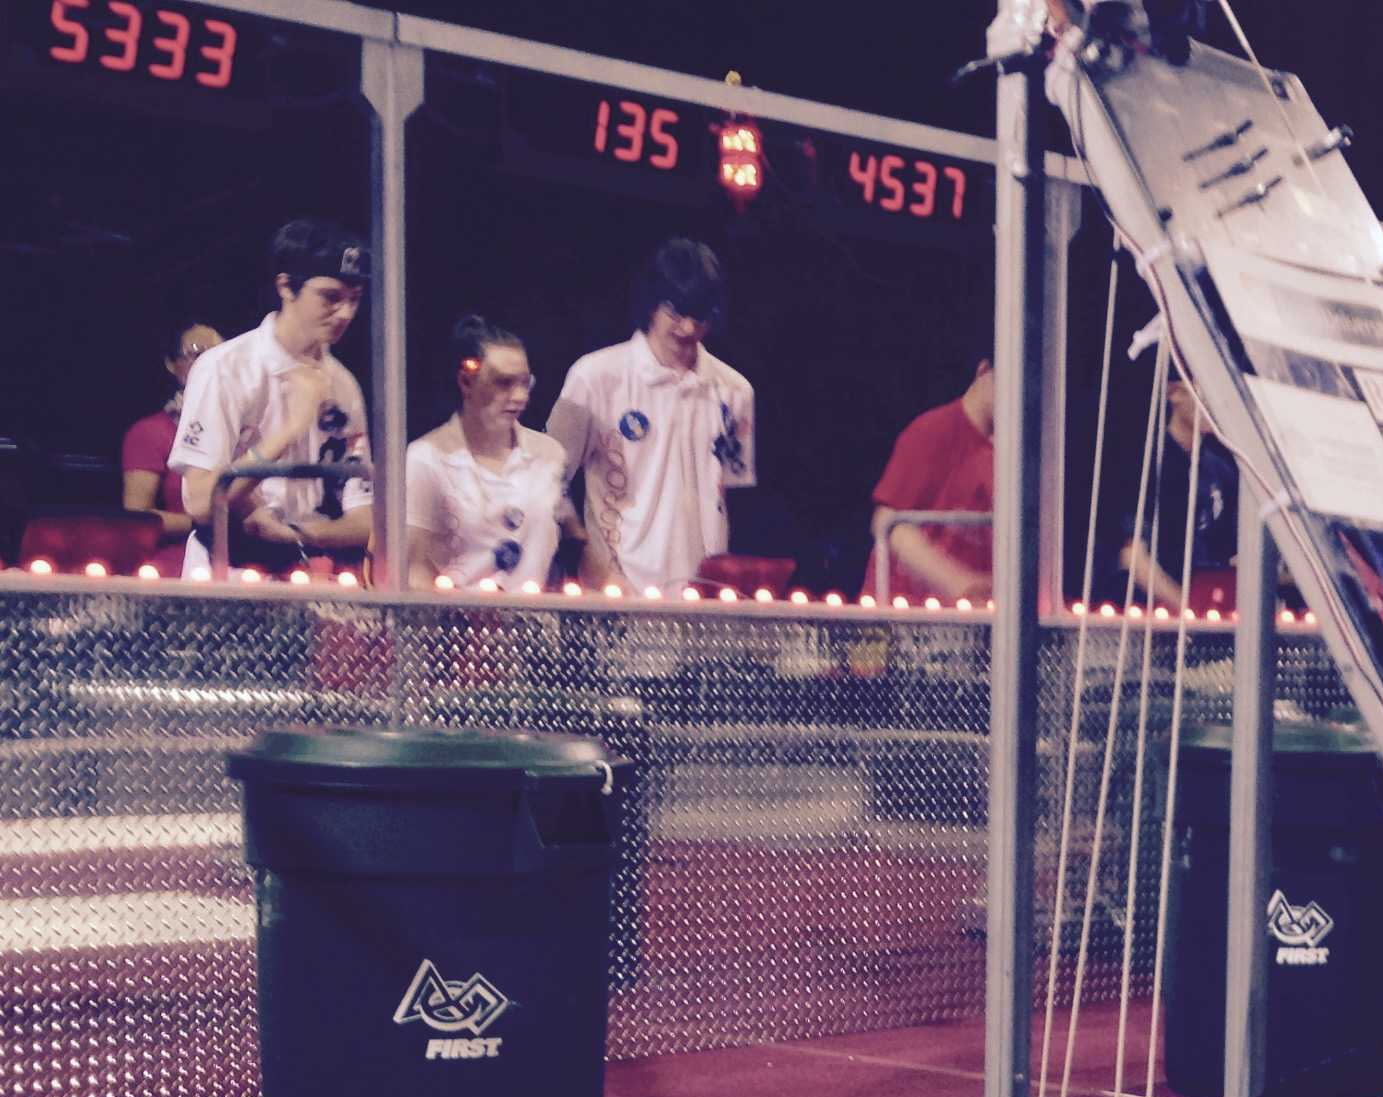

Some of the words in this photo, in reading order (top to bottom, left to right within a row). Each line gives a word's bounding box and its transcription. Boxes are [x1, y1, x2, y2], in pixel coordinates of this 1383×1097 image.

[50, 0, 238, 88] 5333
[594, 101, 679, 169] 135
[849, 152, 966, 218] 4537
[425, 1037, 503, 1060] FIRST
